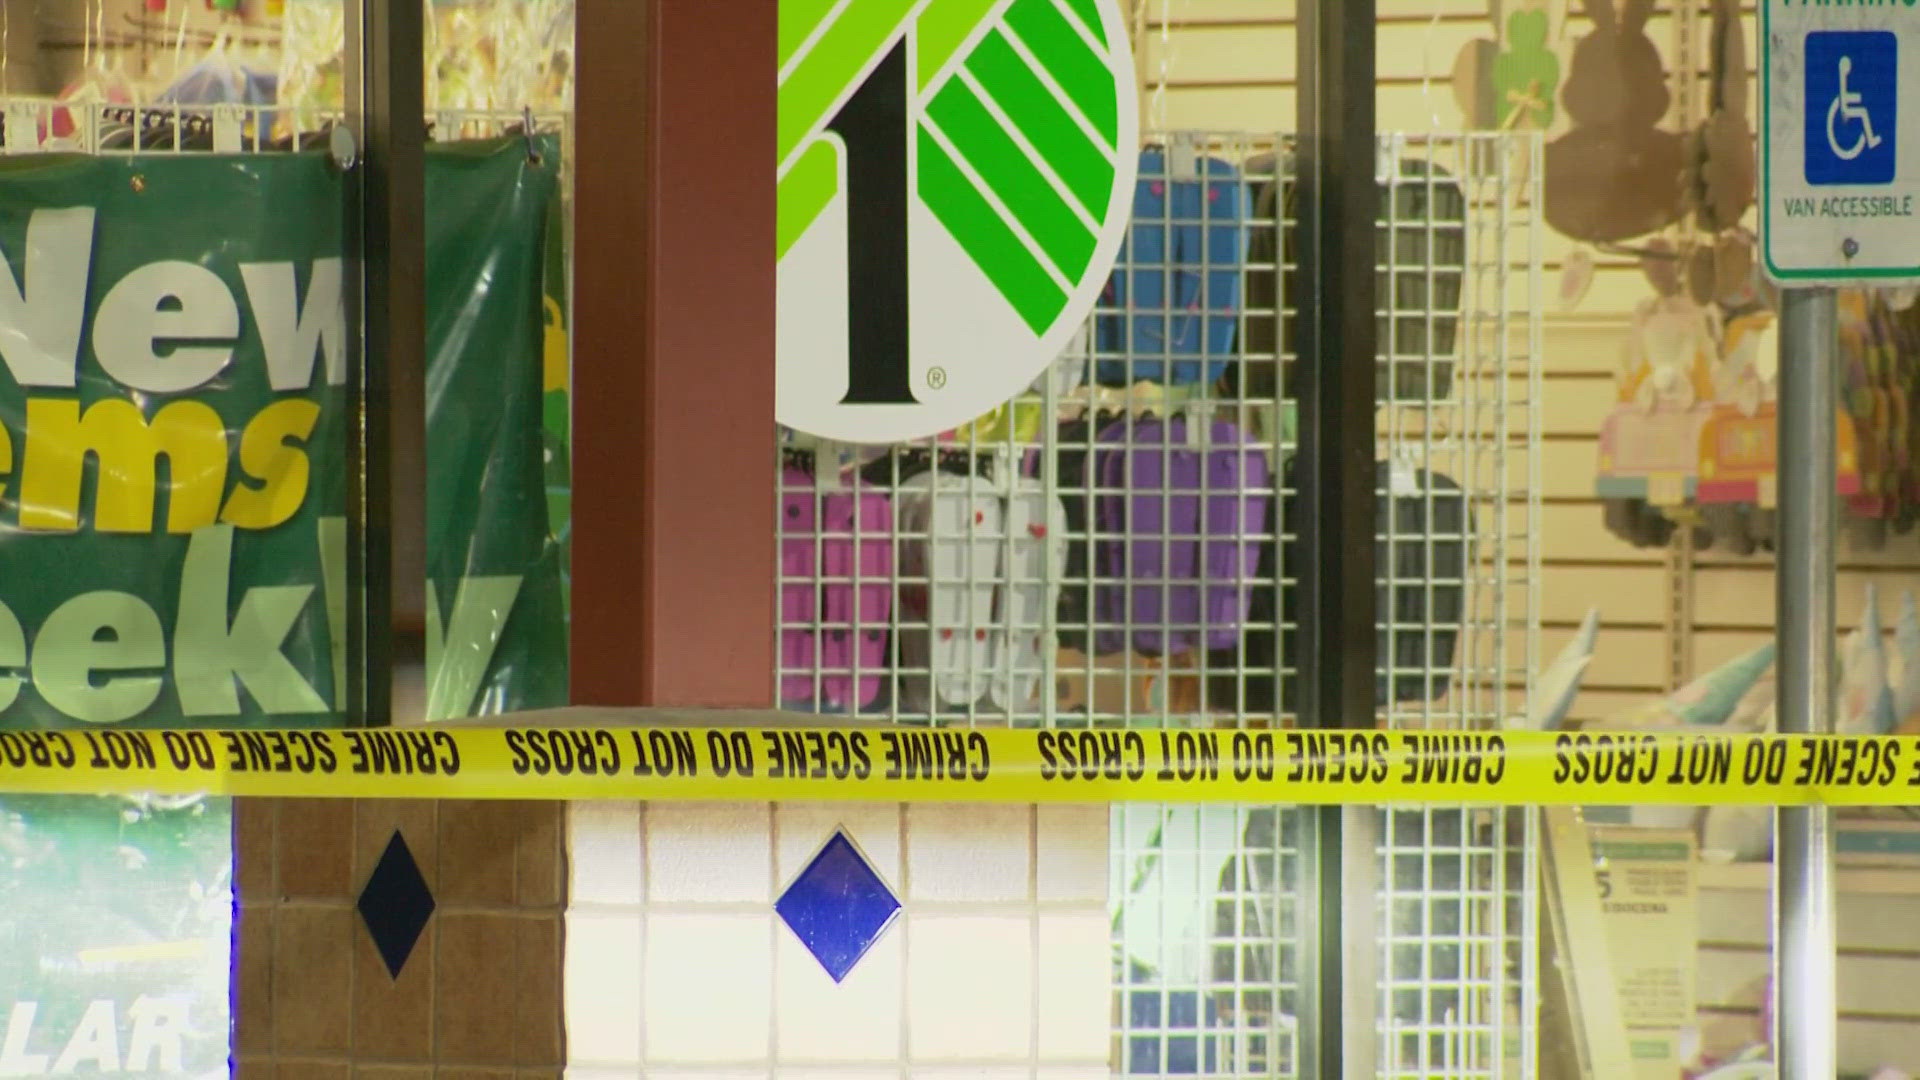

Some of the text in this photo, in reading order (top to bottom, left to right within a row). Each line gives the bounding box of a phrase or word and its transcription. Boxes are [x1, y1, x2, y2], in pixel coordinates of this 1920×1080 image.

[1783, 195, 1913, 217] VAN ACCESSIBLE
[0, 396, 320, 534] ms
[0, 730, 75, 768] CRO
[83, 730, 156, 770] NOT
[161, 730, 216, 771] DO
[219, 730, 337, 774] SCENE
[342, 730, 461, 776] CRIME
[504, 728, 621, 776] CROSS
[631, 729, 697, 777] NOT
[706, 730, 754, 778] DO
[762, 730, 872, 780] SCENE
[881, 731, 990, 781] CRIME
[1037, 731, 1145, 781] CROSS
[1157, 731, 1219, 781] NOT
[1232, 732, 1274, 782] DO
[1286, 733, 1390, 784] SCENE
[1402, 734, 1506, 785] CRIME
[1553, 734, 1659, 784] CROSS
[1667, 736, 1732, 785] NOT
[1742, 737, 1787, 786] DO
[1795, 738, 1900, 786] SCENE
